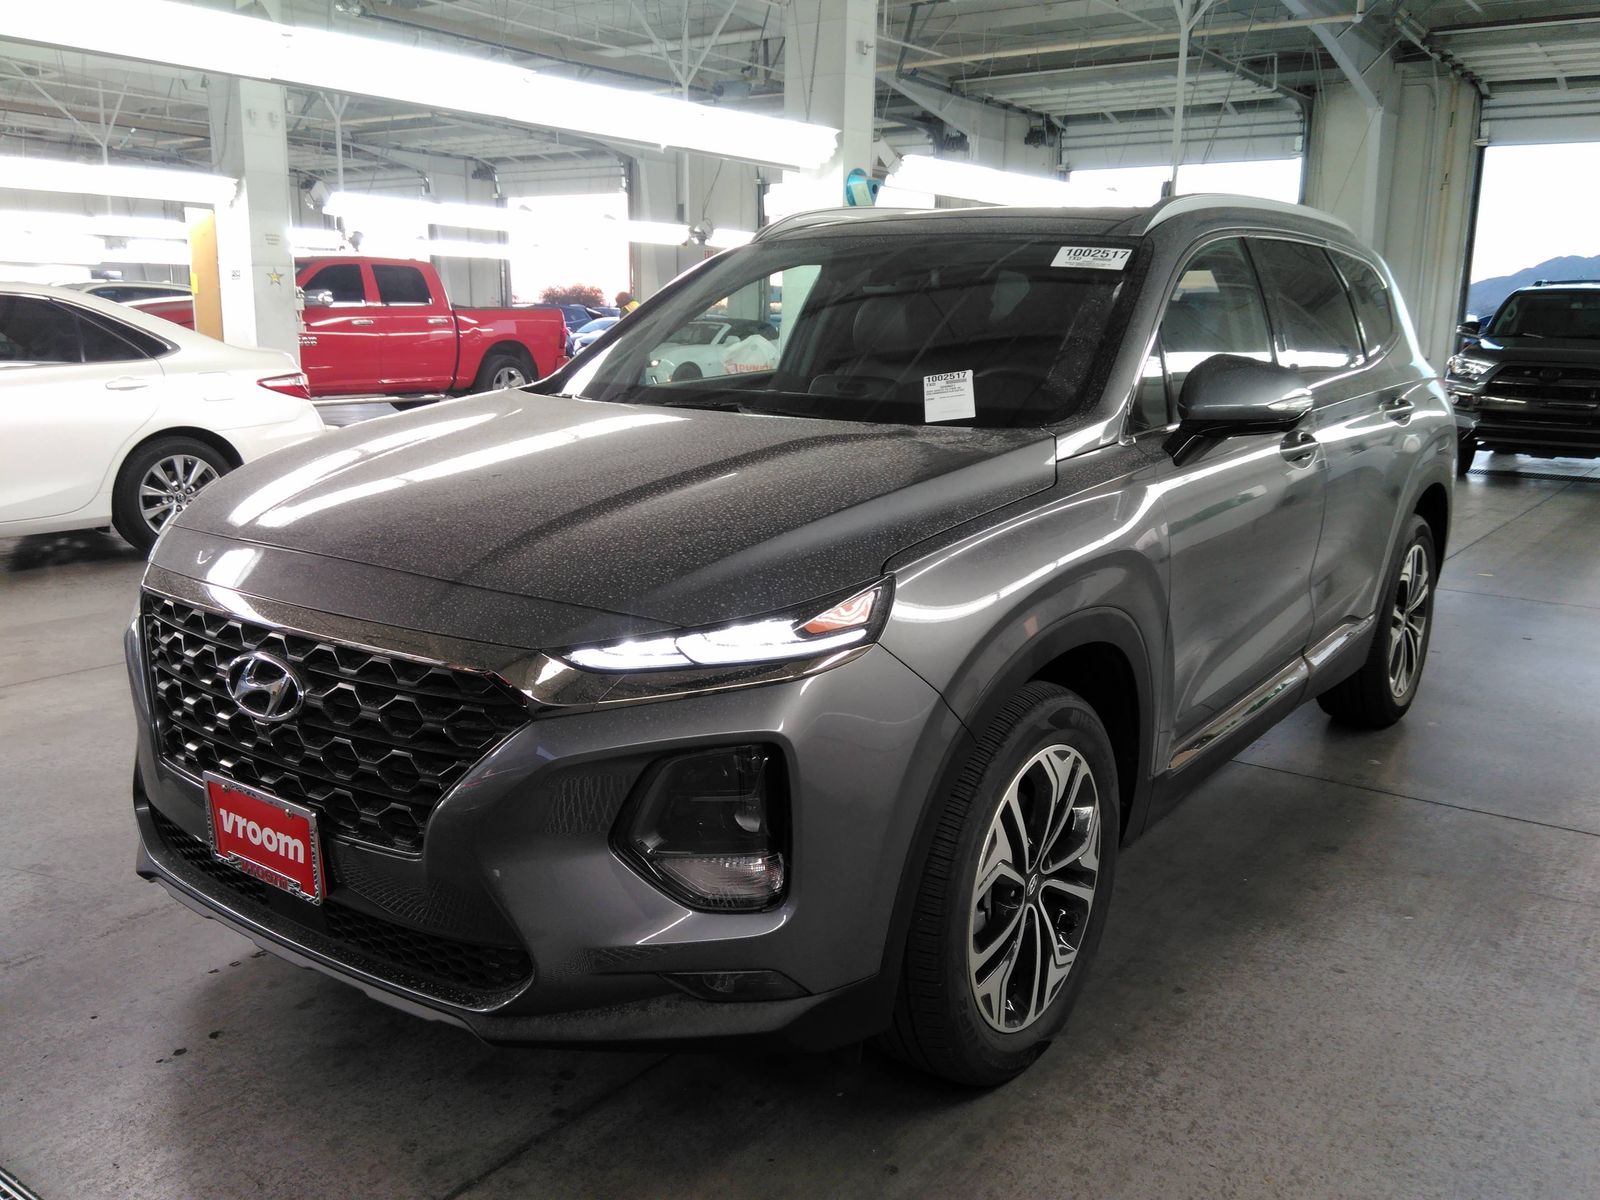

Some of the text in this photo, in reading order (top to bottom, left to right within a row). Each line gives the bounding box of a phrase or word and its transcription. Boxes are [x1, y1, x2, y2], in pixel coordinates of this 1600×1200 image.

[1066, 248, 1129, 259] 1002517
[926, 371, 967, 382] 1002517
[220, 808, 304, 864] vroom
